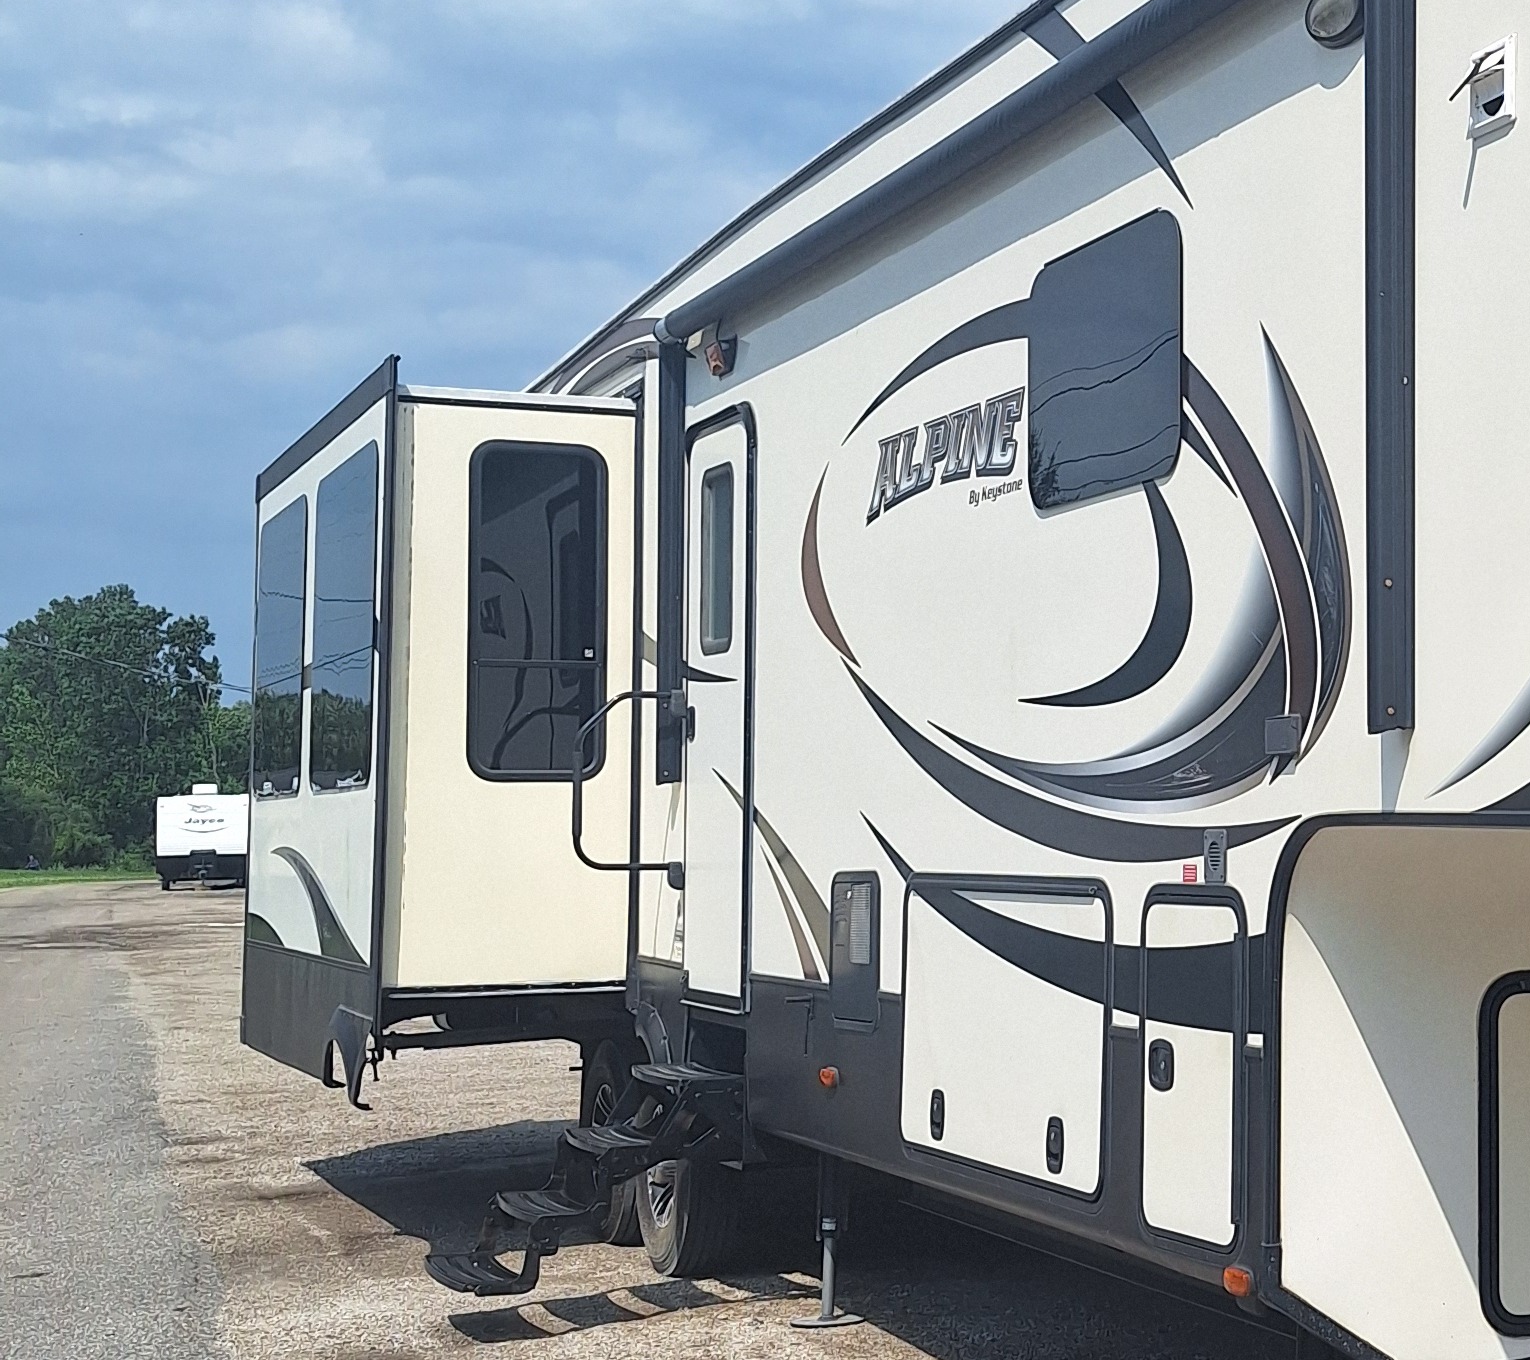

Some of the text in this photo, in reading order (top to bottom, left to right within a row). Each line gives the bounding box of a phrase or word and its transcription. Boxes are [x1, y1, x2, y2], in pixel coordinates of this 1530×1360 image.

[865, 385, 1025, 527] ALPINE
[968, 478, 1023, 508] By Keystone
[184, 817, 225, 825] Jayco
